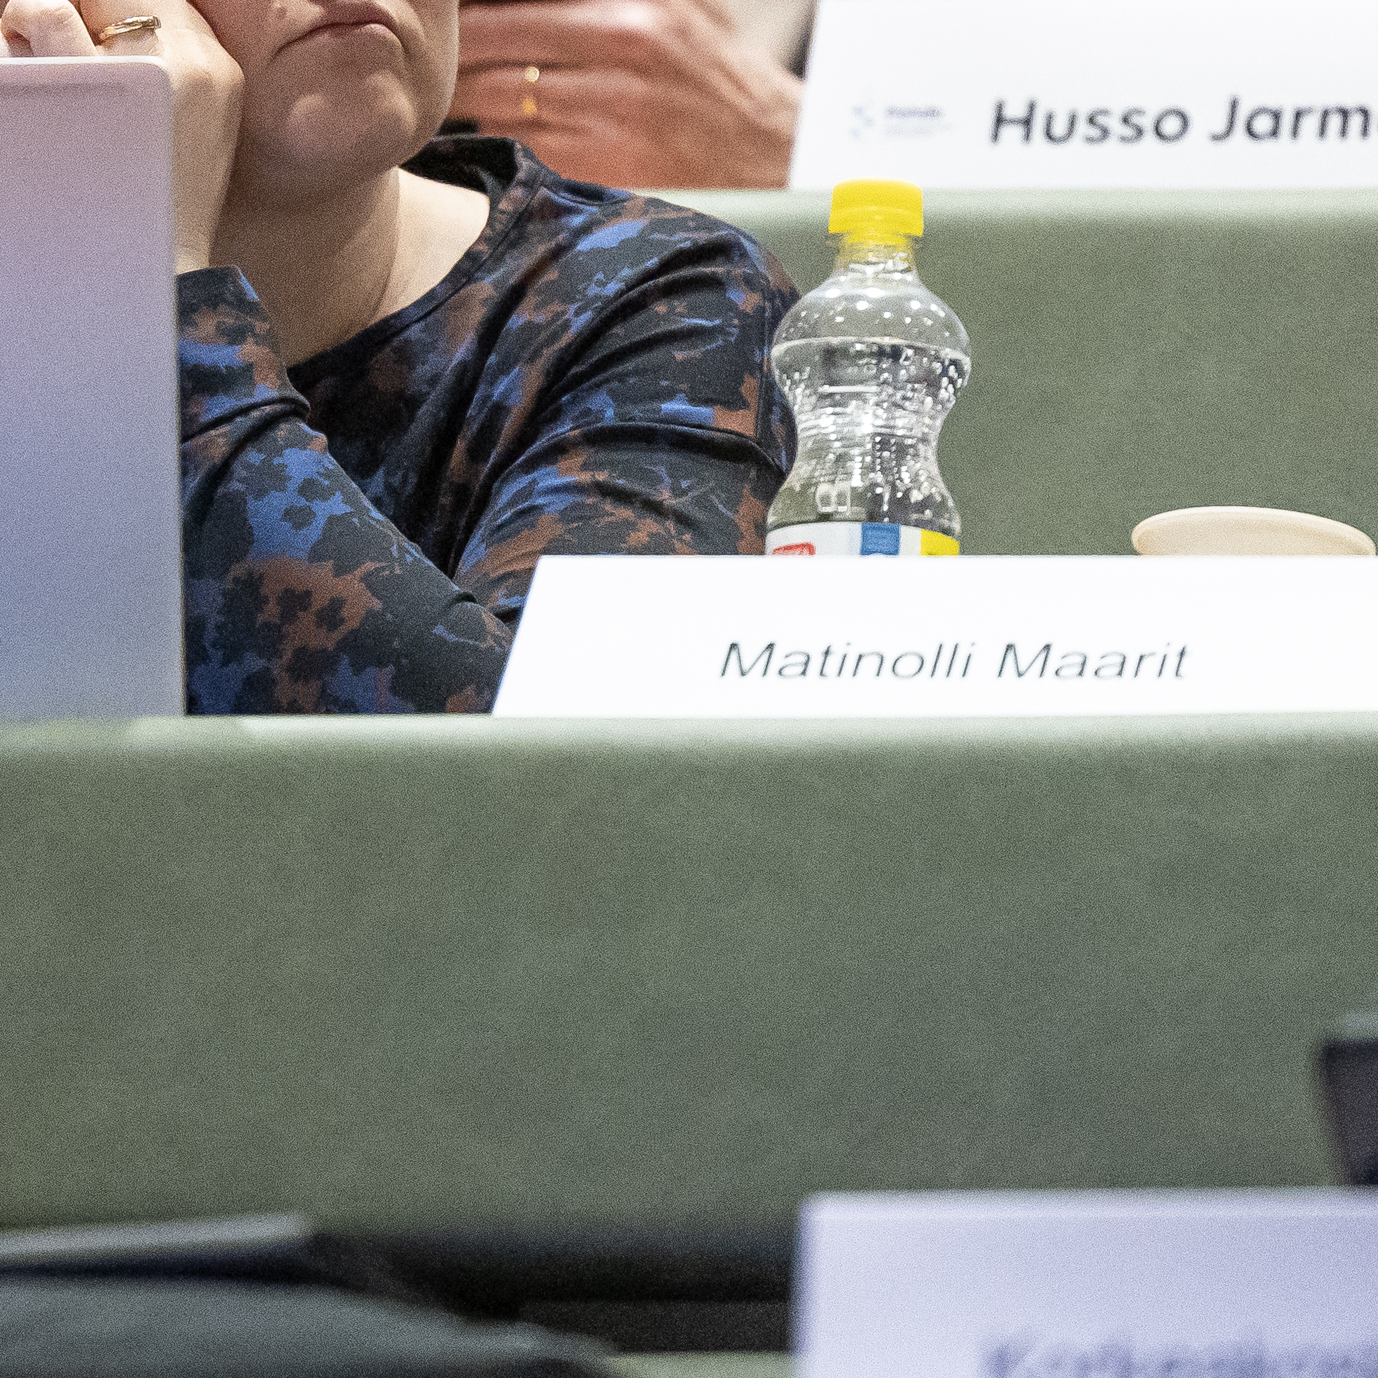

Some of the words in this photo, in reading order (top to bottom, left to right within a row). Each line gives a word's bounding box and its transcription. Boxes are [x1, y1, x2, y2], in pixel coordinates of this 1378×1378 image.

[990, 97, 1191, 145] Husso
[720, 640, 976, 680] Matinolli
[996, 640, 1189, 680] Maarit
